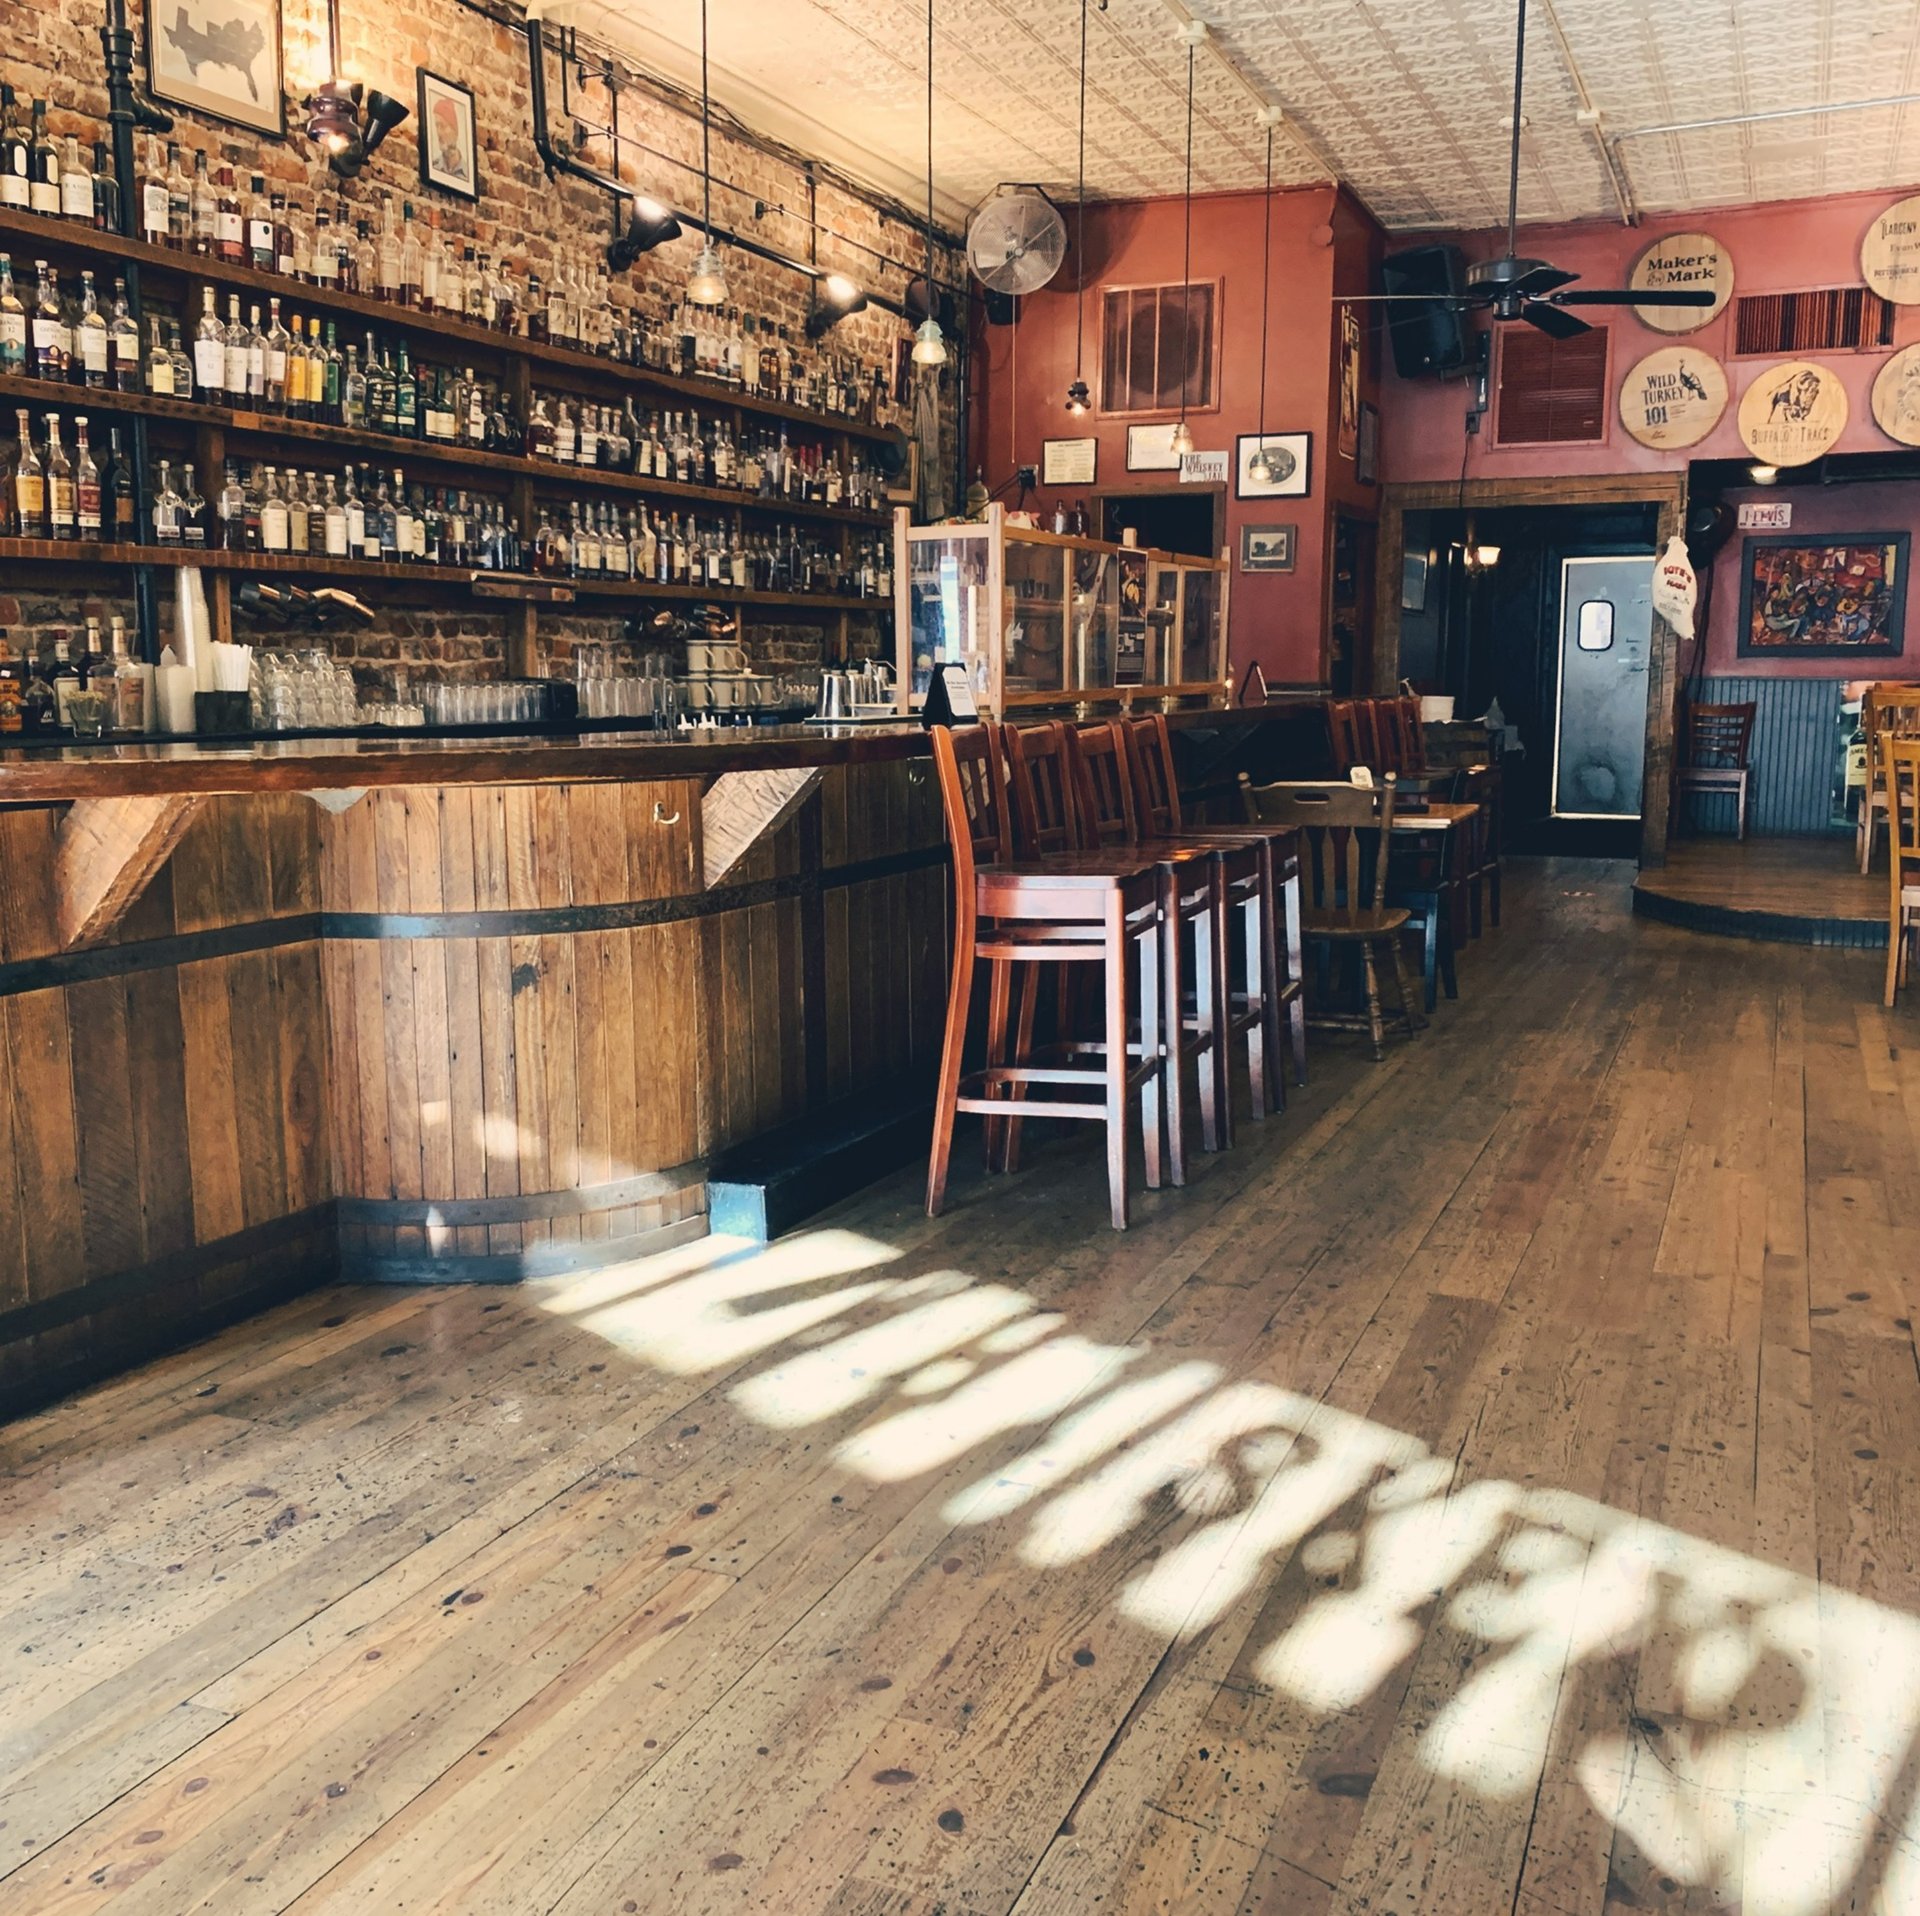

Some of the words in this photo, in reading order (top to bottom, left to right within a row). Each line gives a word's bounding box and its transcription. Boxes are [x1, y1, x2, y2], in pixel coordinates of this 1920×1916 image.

[1647, 253, 1718, 271] Maker's
[1667, 268, 1714, 283] Mark
[1646, 374, 1676, 389] WILD
[1641, 386, 1683, 405] TURKEY
[1644, 405, 1668, 426] 101
[1184, 454, 1201, 463] THE
[1185, 462, 1223, 473] WHISKEY
